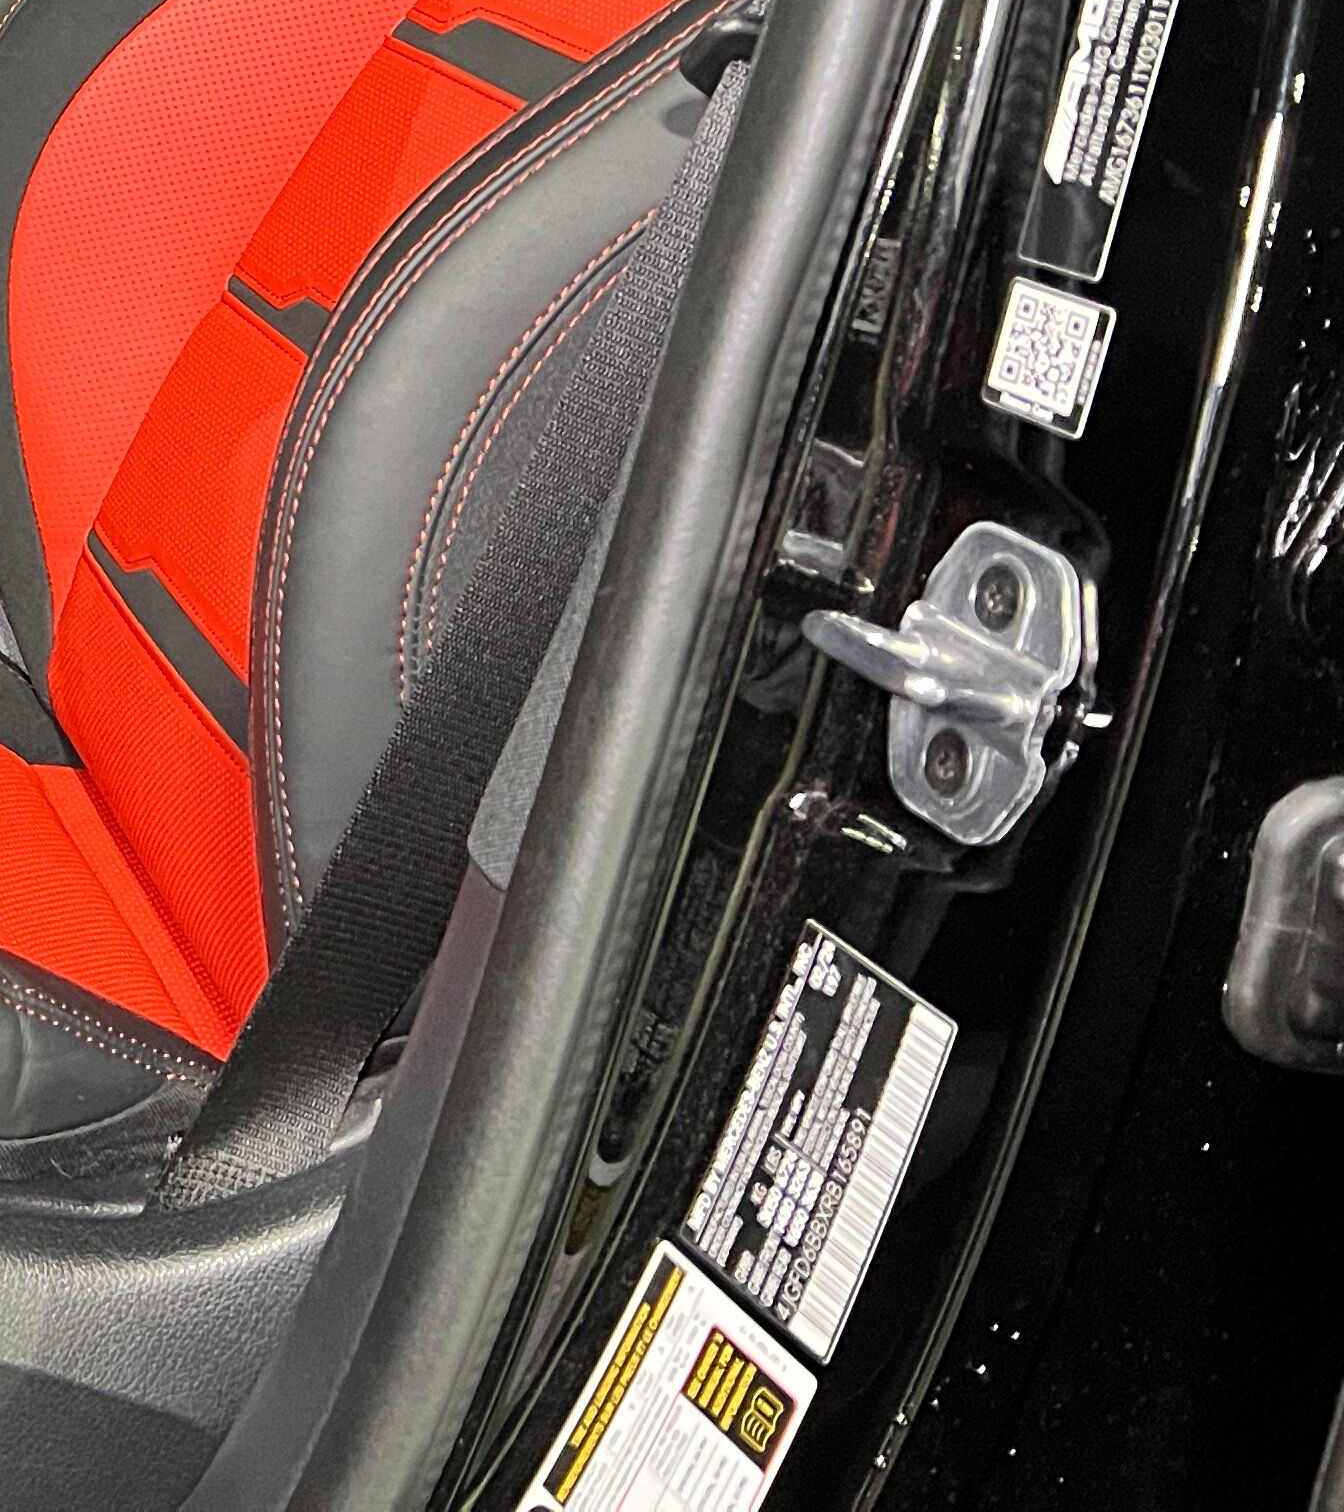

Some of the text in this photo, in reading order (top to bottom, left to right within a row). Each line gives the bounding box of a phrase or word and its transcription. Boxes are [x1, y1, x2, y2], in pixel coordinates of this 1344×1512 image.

[1062, 43, 1112, 183] Mercedes-AMG
[1077, 72, 1121, 187] Affalterbach
[711, 1046, 772, 1175] MERCEDES-BENZ
[774, 1105, 873, 1326] 4JGFD6BBXRB165891
